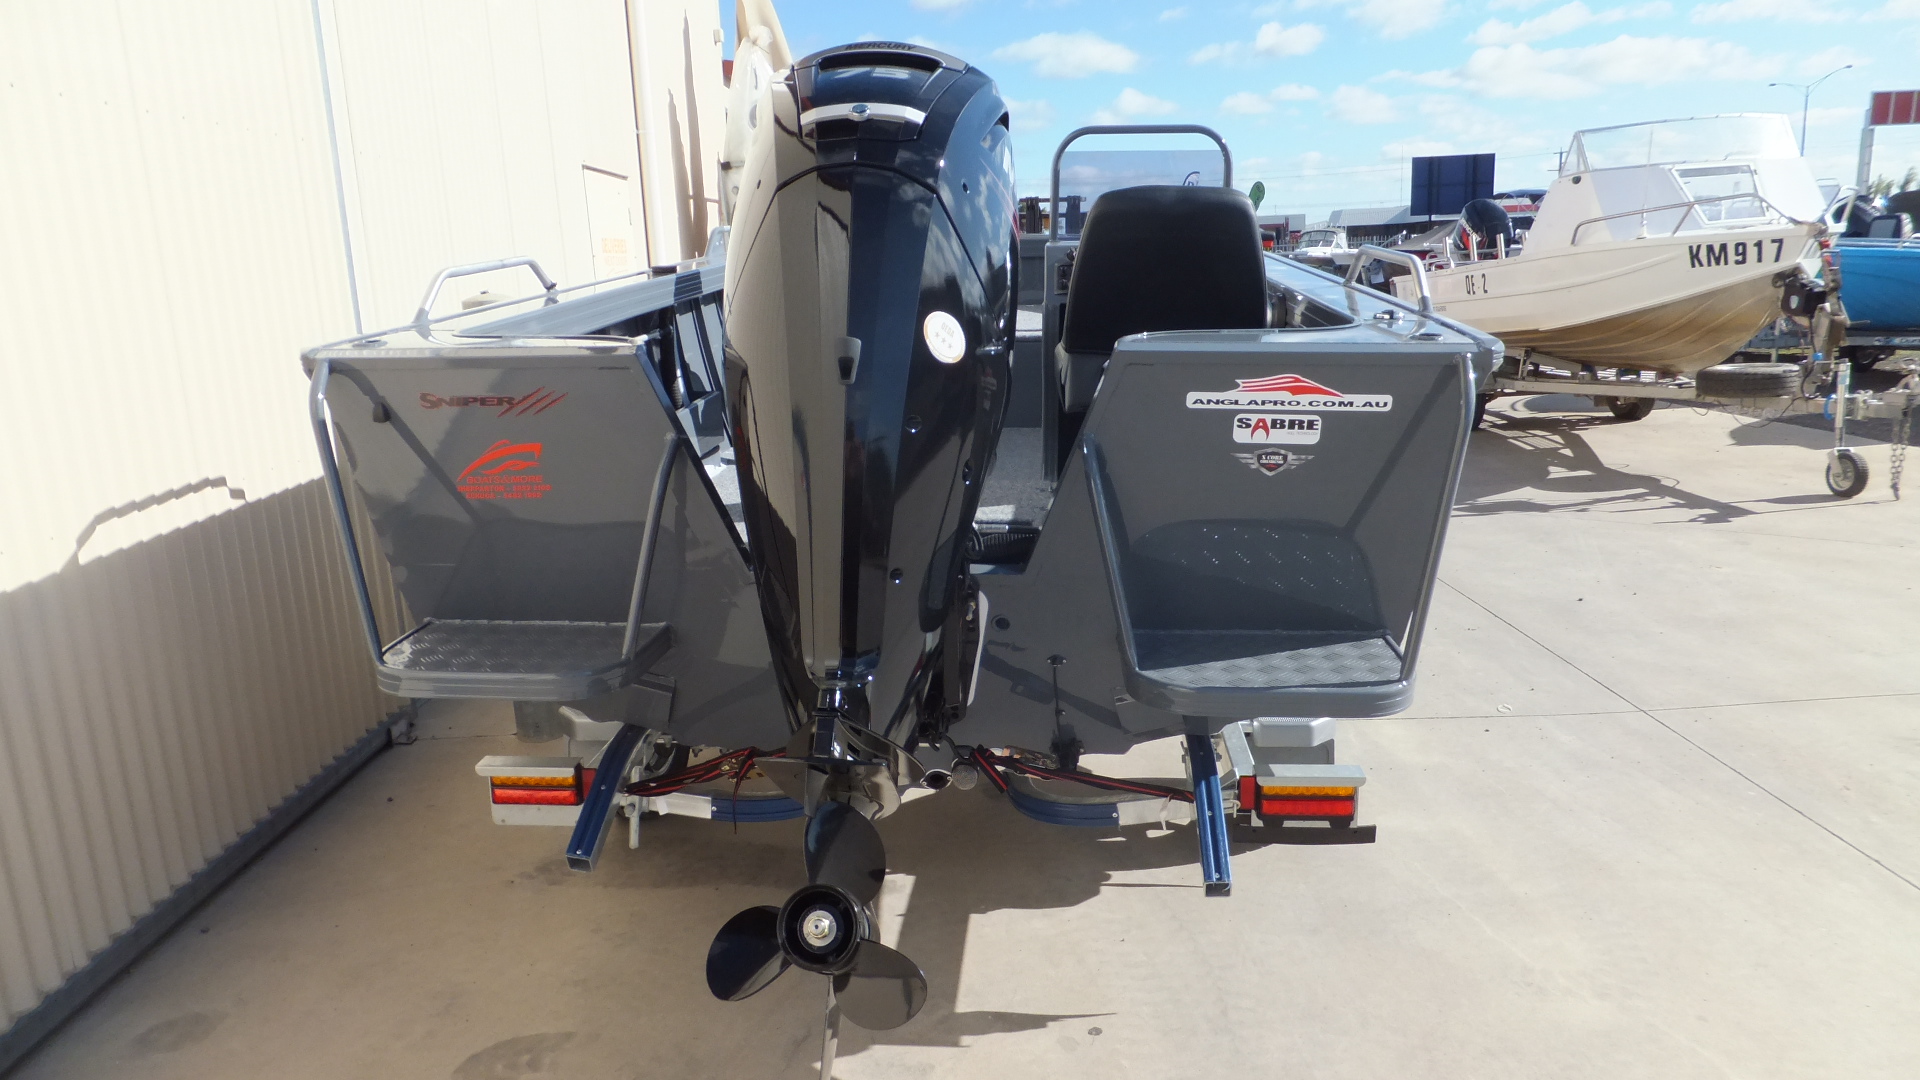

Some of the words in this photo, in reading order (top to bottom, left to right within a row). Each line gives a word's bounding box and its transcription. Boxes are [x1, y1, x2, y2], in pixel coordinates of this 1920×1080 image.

[845, 42, 916, 51] MERCURY
[1688, 238, 1784, 268] KM917
[419, 391, 517, 410] SNIPER
[1191, 397, 1389, 409] ANGLAPRO.COM.AU
[1236, 417, 1321, 440] SABRE
